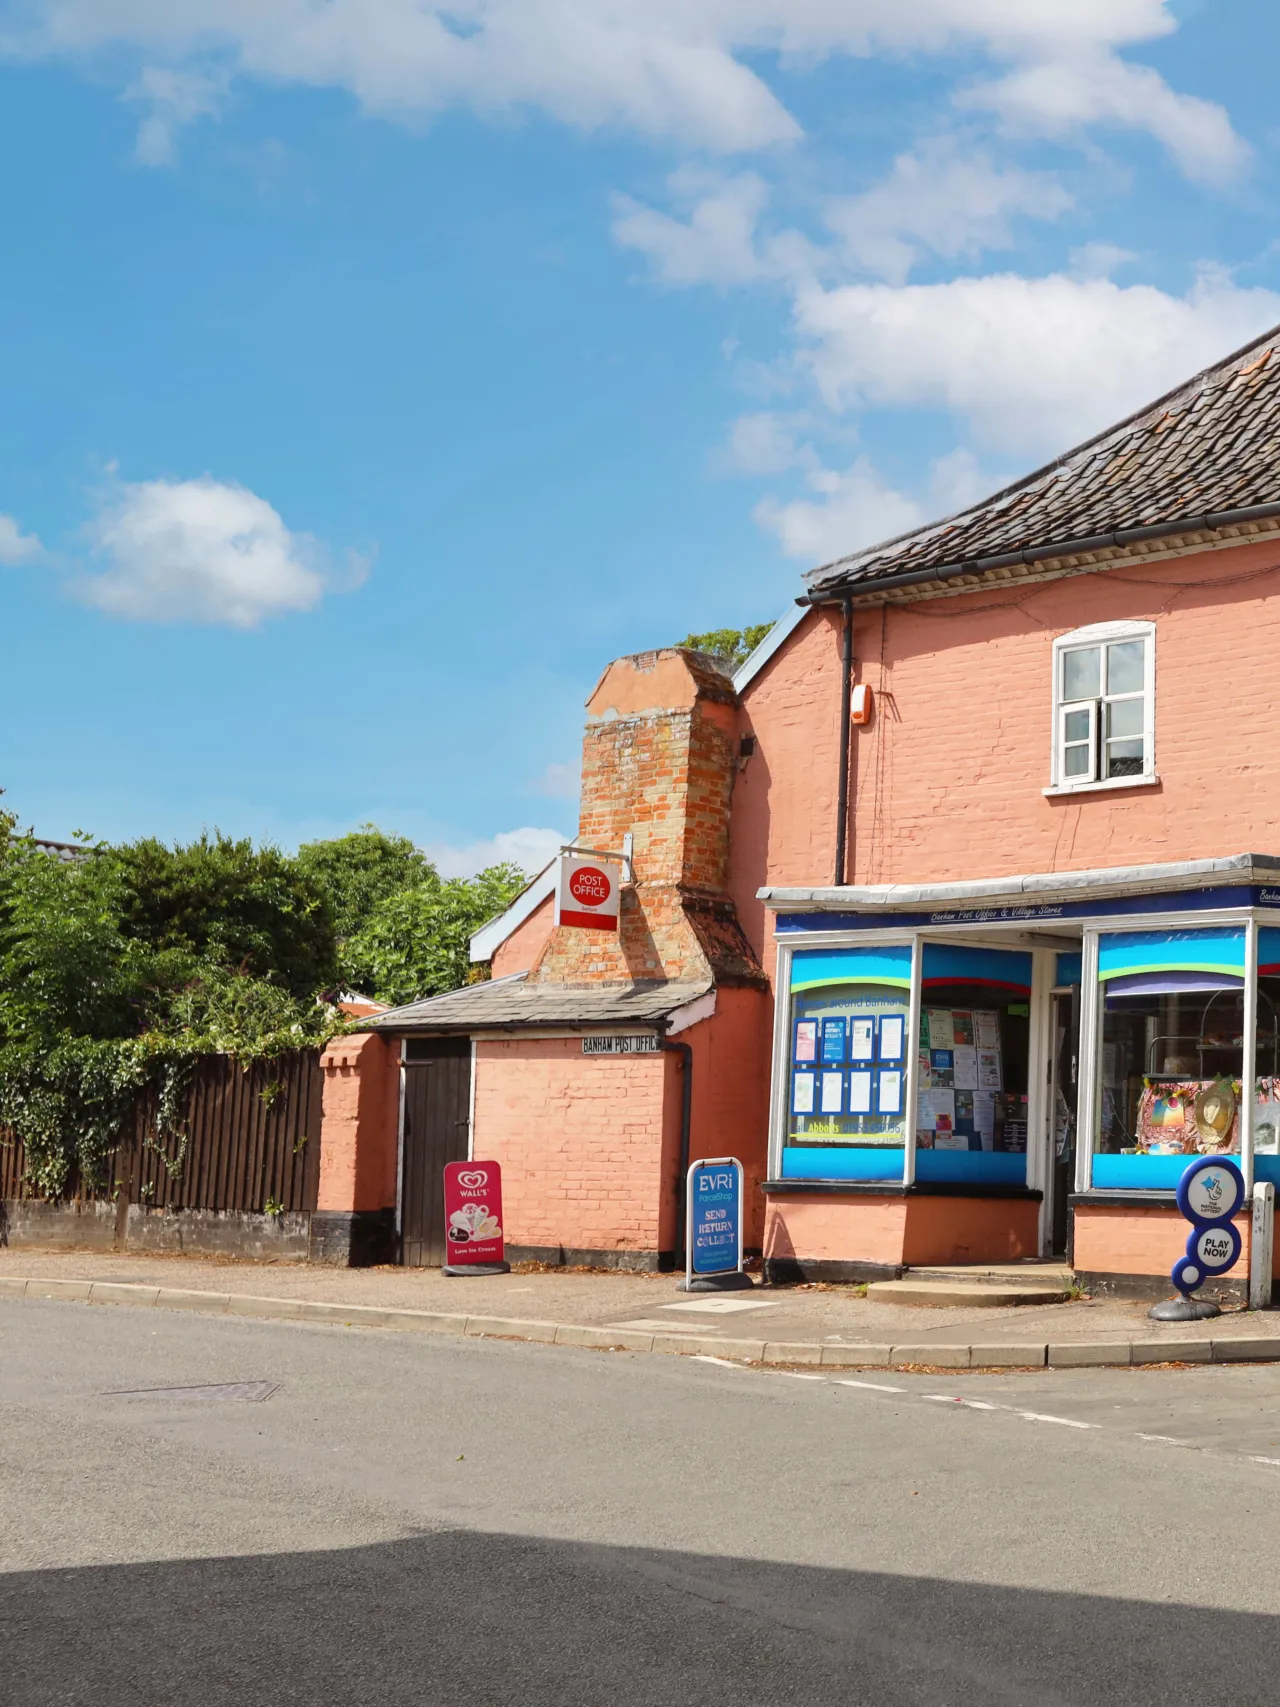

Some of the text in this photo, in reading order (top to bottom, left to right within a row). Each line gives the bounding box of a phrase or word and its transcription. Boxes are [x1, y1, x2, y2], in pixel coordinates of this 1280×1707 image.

[580, 875, 603, 886] POST
[573, 884, 605, 898] OFFICE
[931, 904, 1062, 921] Banham Post Office & Village Stores
[583, 1037, 612, 1053] BANHAM
[616, 1036, 632, 1052] POST
[460, 1189, 487, 1197] WALL'S
[699, 1192, 733, 1202] ParcelShop
[705, 1209, 726, 1220] SEND
[698, 1220, 732, 1234] RETURN
[697, 1233, 735, 1247] COLLECT
[1205, 1238, 1230, 1249] PLAY
[1203, 1247, 1229, 1258] NOW
